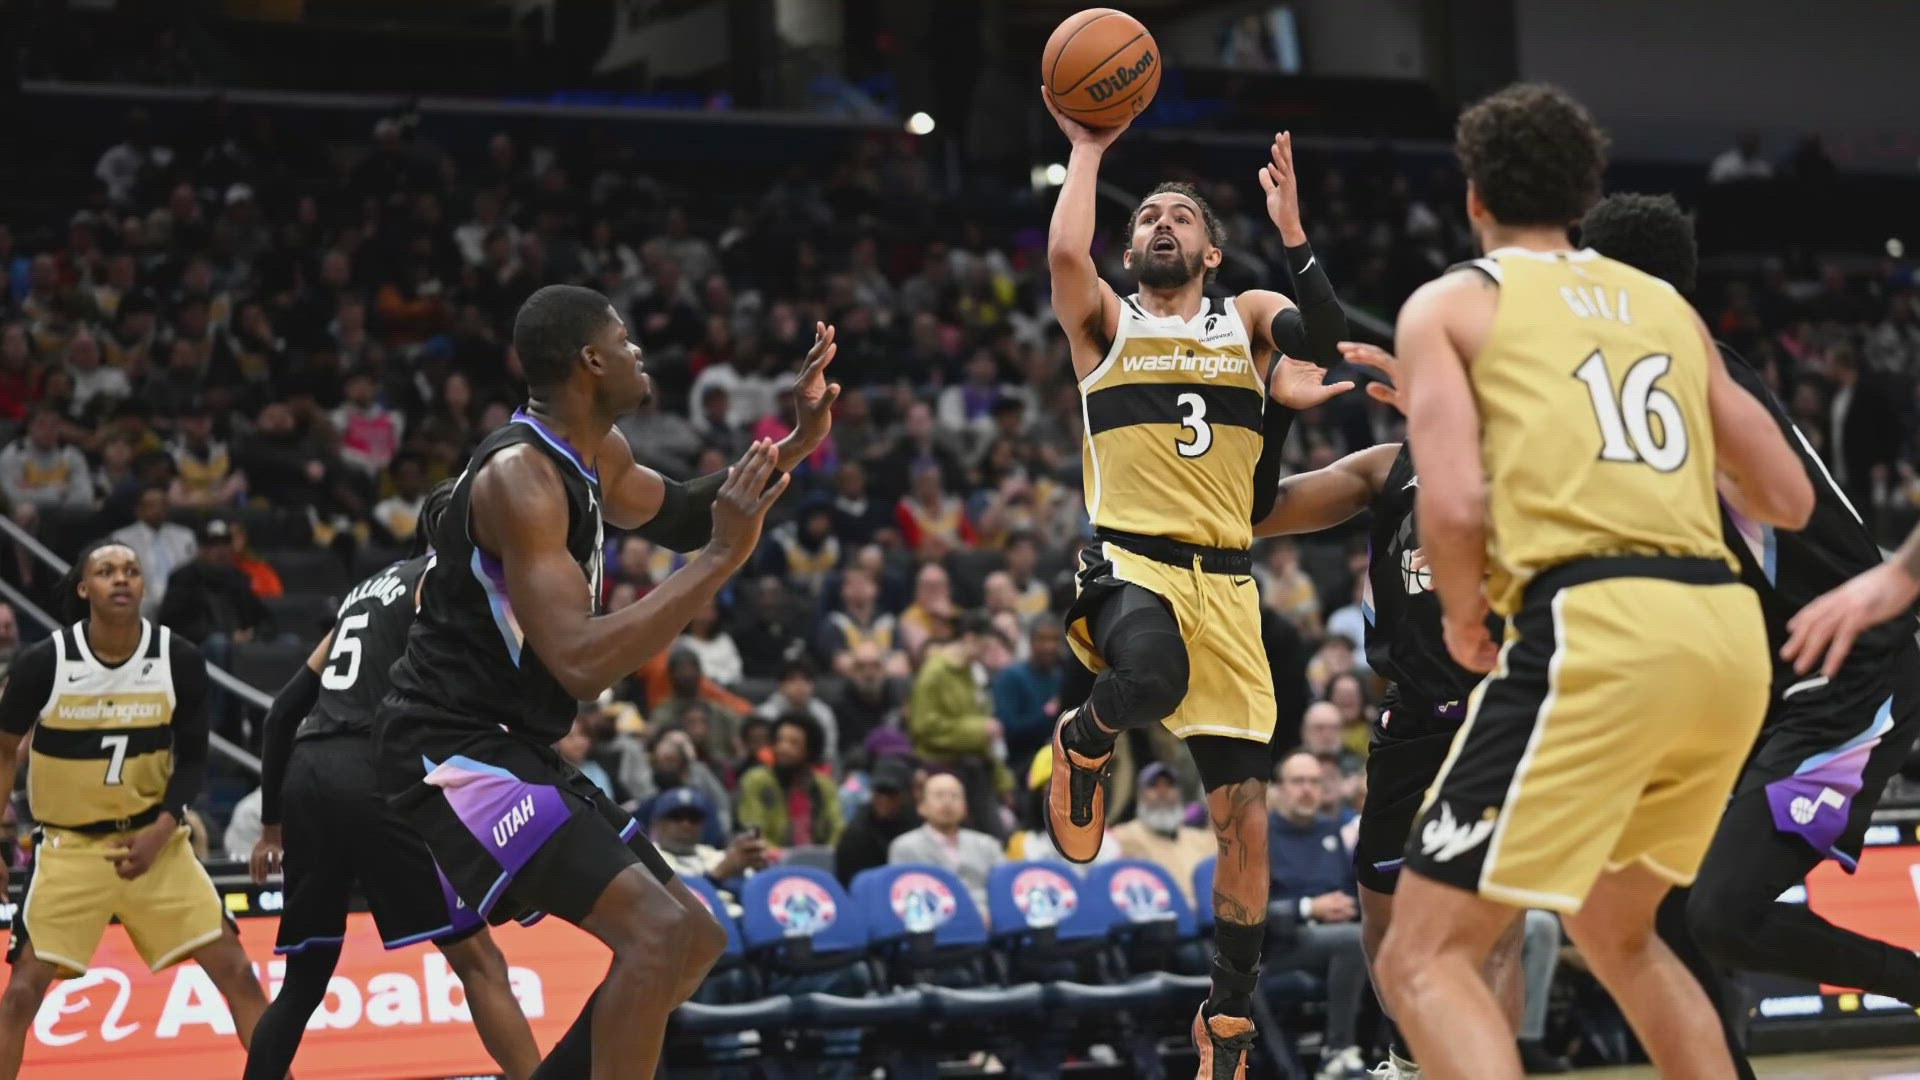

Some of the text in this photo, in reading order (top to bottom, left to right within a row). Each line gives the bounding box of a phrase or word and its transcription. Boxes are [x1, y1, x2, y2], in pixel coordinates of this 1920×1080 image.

[1084, 49, 1154, 102] Wilson
[1559, 284, 1632, 325] GILL
[1122, 345, 1249, 379] washington
[1175, 392, 1214, 459] 3
[1571, 348, 1689, 474] 16
[321, 611, 369, 690] 5
[100, 735, 129, 786] 7
[492, 793, 535, 848] UTAH
[154, 951, 545, 1038] Ababa
